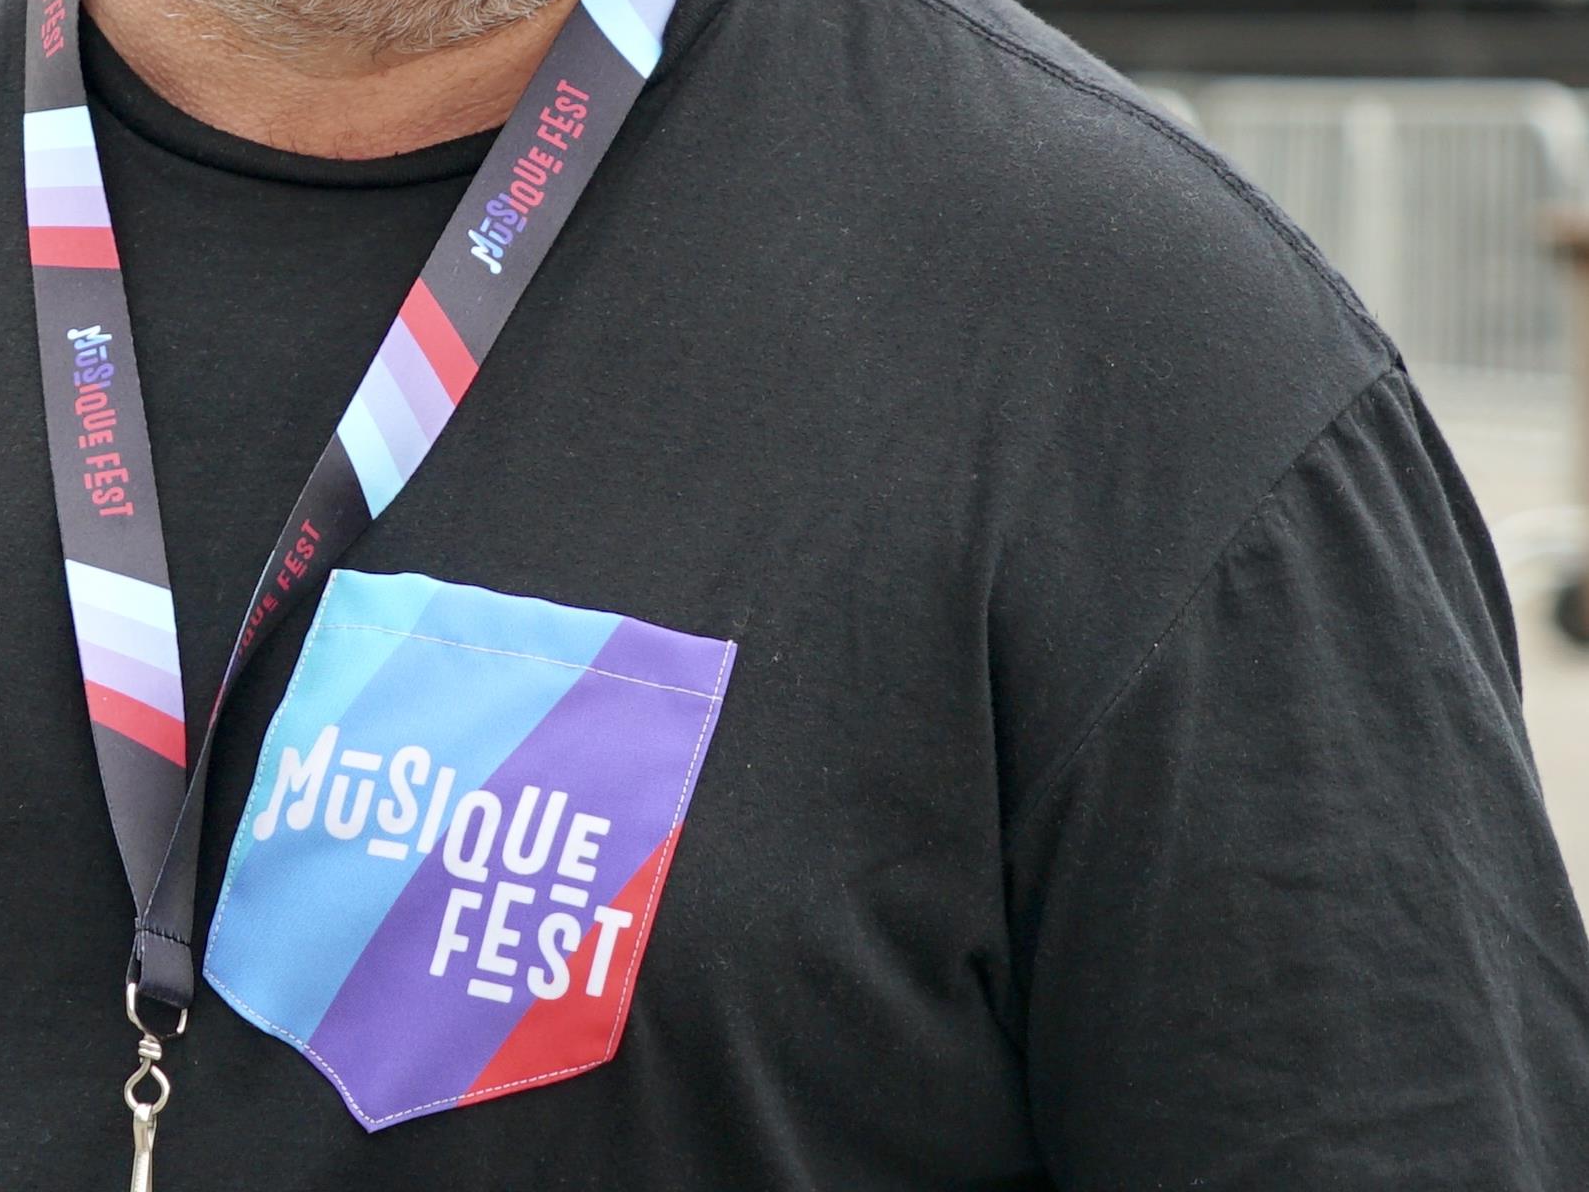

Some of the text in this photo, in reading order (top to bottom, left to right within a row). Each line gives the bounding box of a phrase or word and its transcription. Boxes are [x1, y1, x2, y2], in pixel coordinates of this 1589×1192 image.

[536, 79, 590, 151] FEST
[83, 452, 135, 517] FEST
[275, 518, 322, 591] FEST
[429, 881, 634, 1003] FEST
